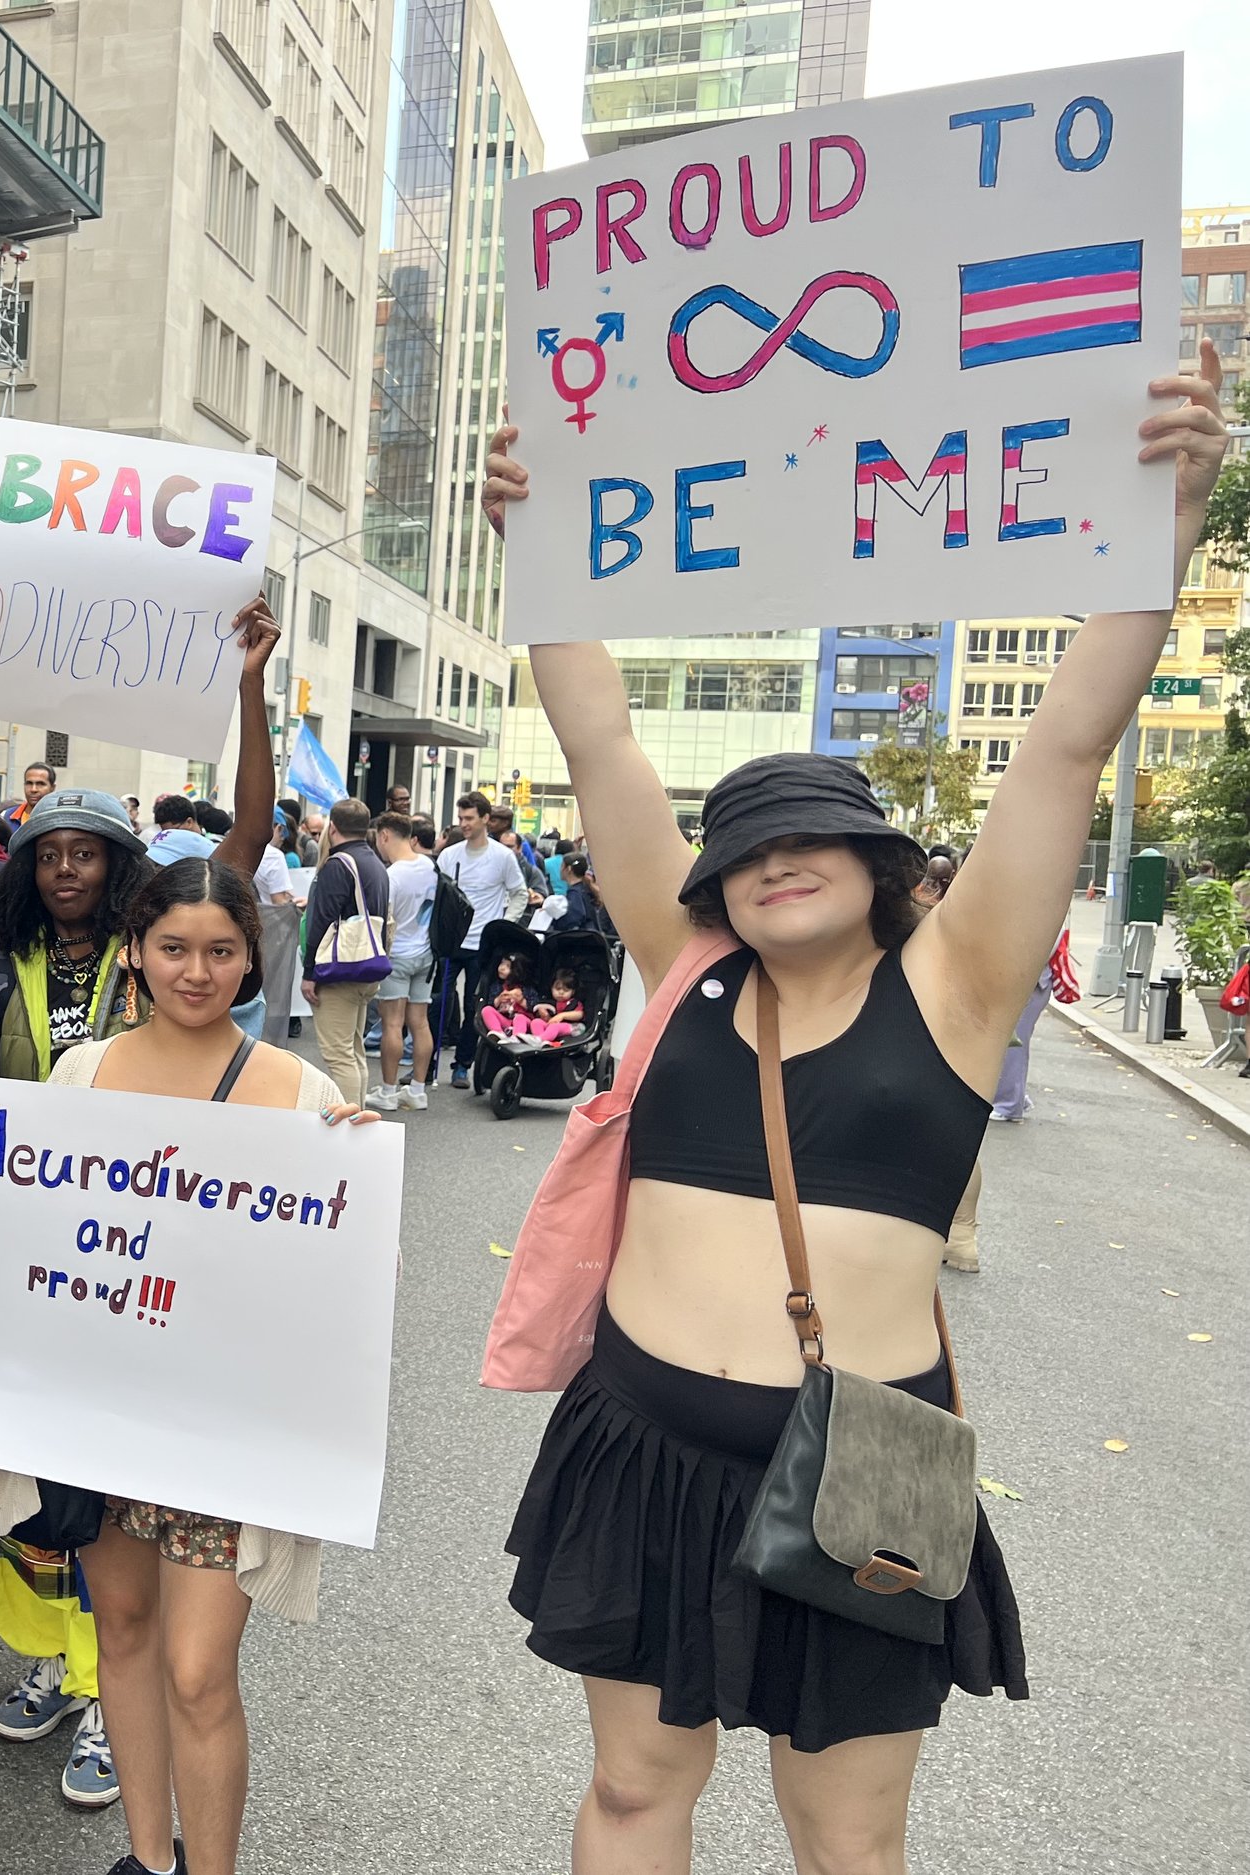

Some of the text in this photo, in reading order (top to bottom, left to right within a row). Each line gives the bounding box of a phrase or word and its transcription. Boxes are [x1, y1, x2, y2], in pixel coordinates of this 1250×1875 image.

[532, 95, 1114, 290] PROUD TO
[588, 460, 747, 580] BE
[1151, 680, 1159, 694] E
[1162, 680, 1179, 694] 24
[76, 1218, 152, 1261] and
[27, 1264, 177, 1328] proud!!!
